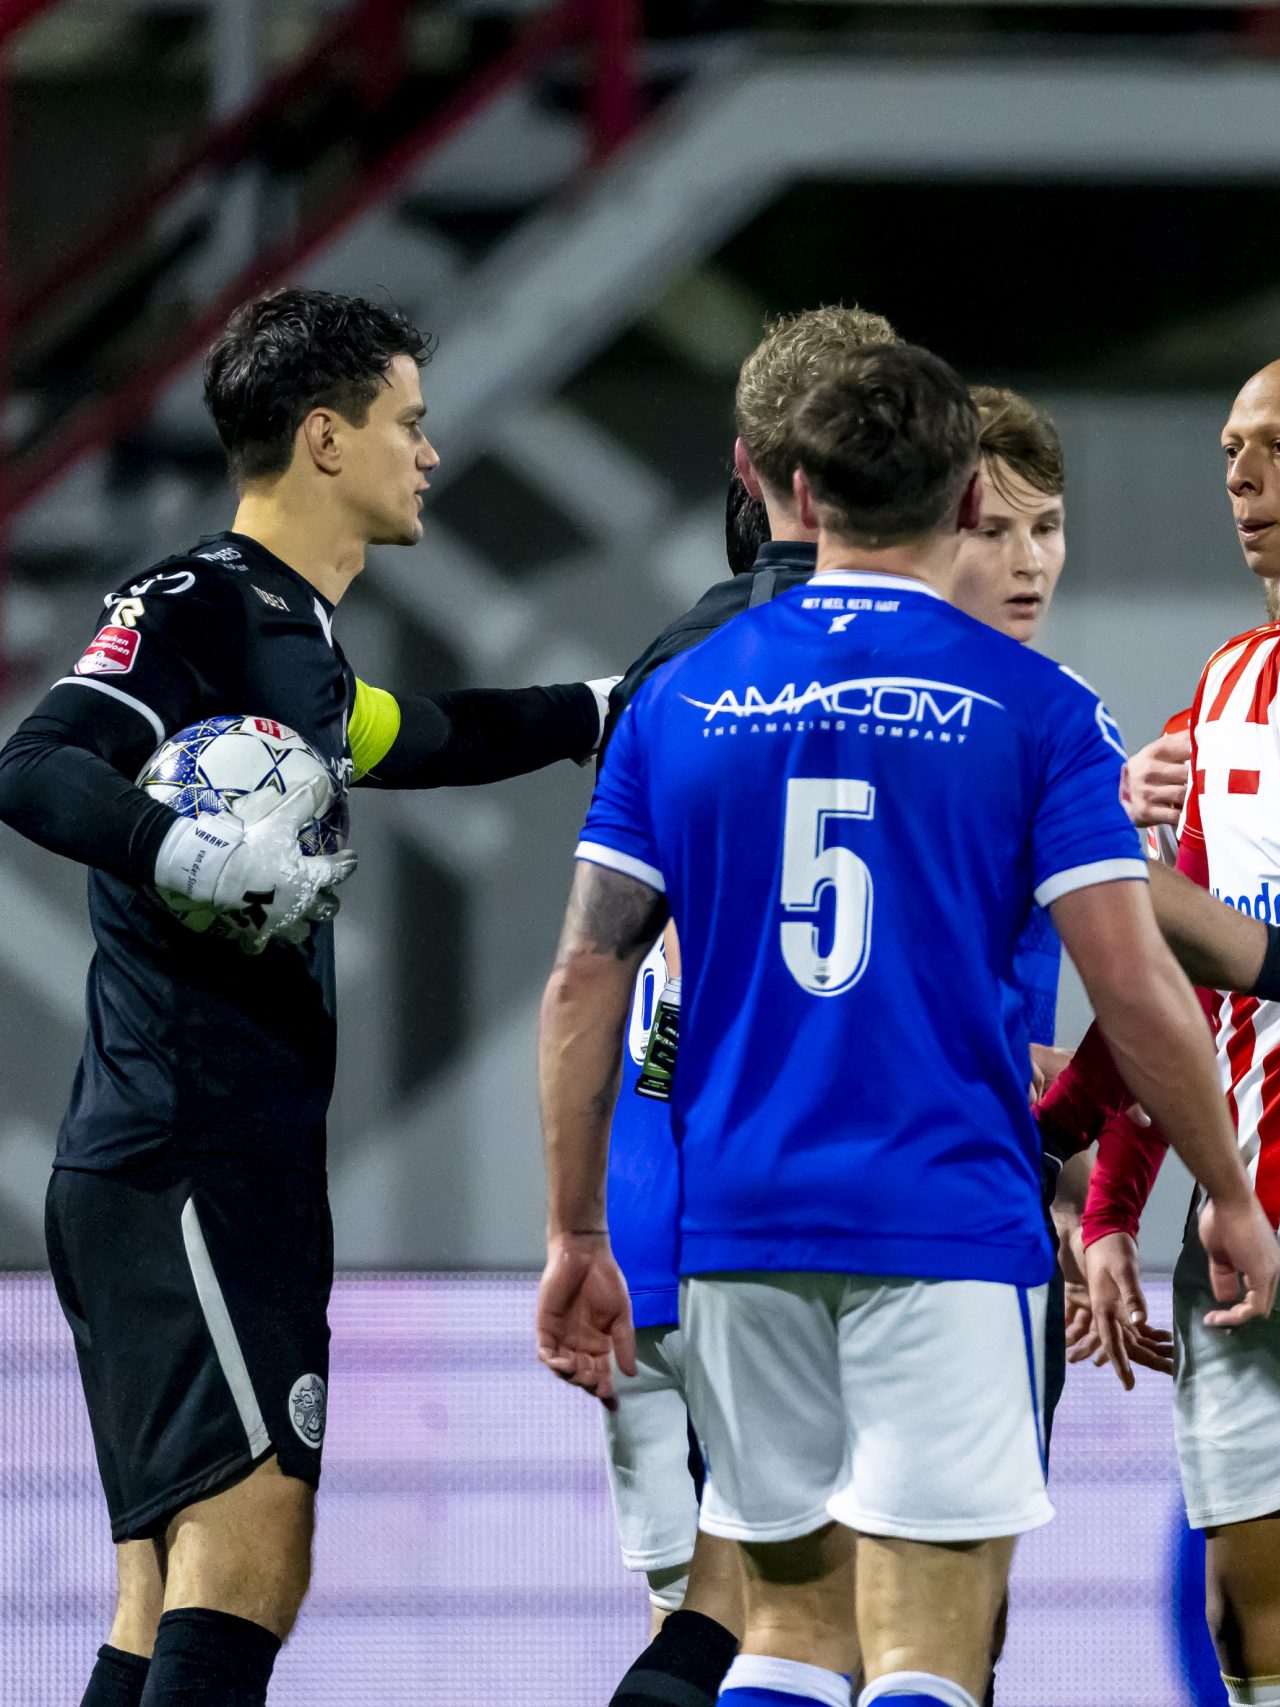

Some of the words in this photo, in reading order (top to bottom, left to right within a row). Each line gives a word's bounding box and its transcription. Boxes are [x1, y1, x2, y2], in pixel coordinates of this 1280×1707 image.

[704, 680, 973, 727] AMACOM
[703, 724, 738, 738] THE
[750, 720, 846, 733] AMAZING
[858, 723, 967, 744] COMPANY
[780, 777, 875, 997] 5
